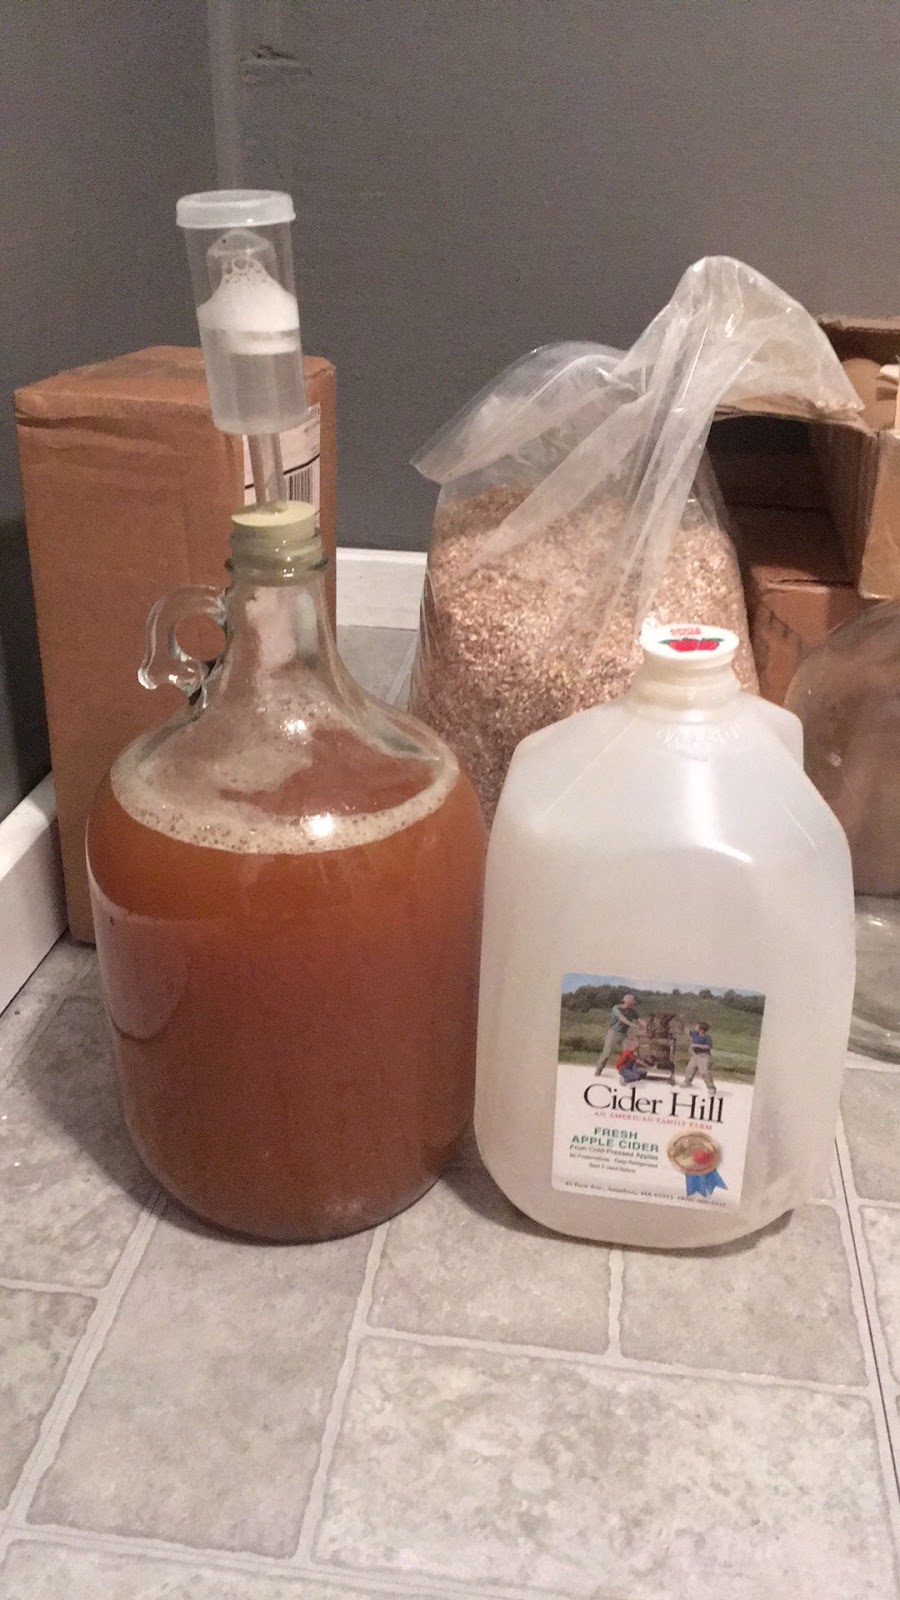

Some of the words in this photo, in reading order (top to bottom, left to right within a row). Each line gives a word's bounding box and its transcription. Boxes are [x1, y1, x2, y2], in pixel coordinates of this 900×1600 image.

[583, 1083, 664, 1115] Cider
[669, 1091, 724, 1124] Hill
[594, 1110, 607, 1118] AN
[609, 1112, 654, 1123] AMERICAN
[656, 1117, 687, 1128] FAMILY
[689, 1121, 713, 1131] FARM
[594, 1127, 638, 1140] FRESH
[571, 1135, 615, 1148] APPLE
[618, 1140, 659, 1153] CIDER
[636, 1153, 659, 1161] Apples
